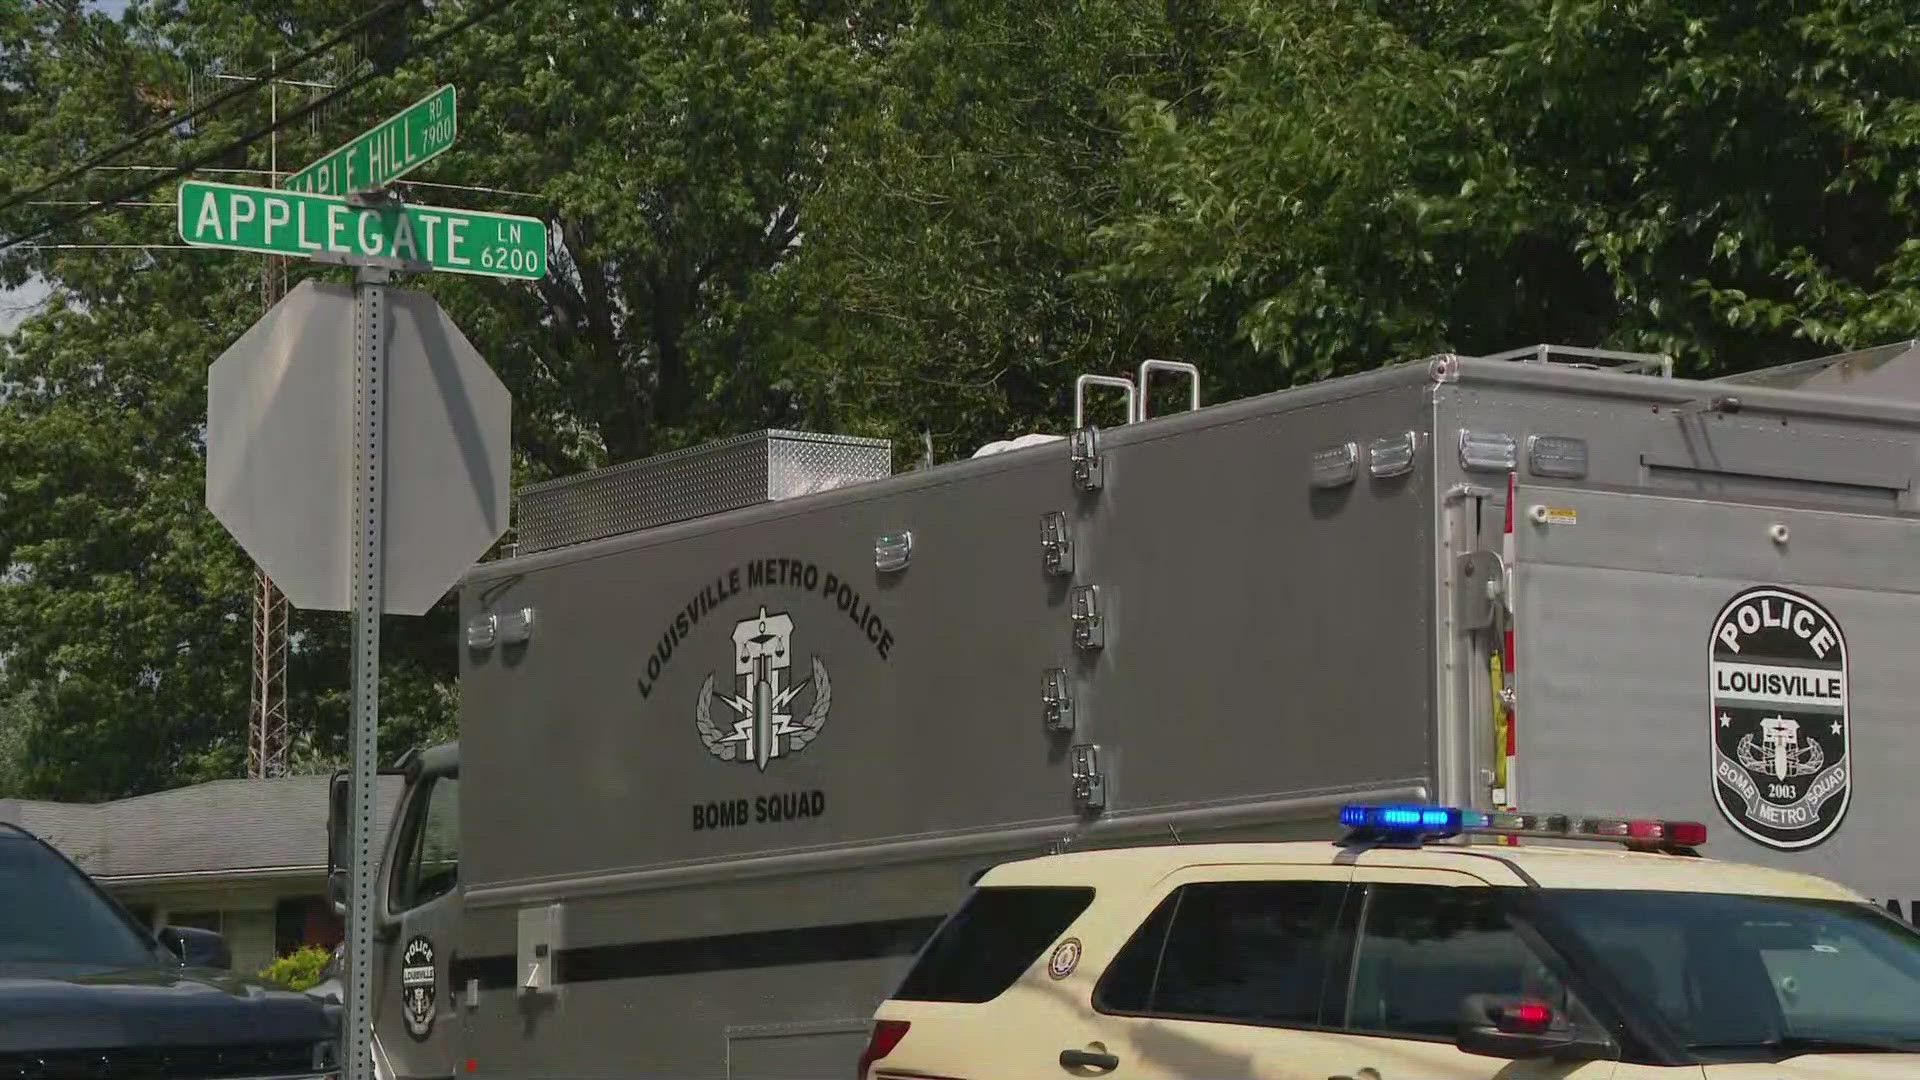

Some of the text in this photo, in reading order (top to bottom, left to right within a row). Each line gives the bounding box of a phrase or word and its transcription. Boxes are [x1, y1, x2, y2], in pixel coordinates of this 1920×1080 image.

[430, 97, 443, 123] RD
[422, 116, 451, 154] 7900
[286, 116, 416, 197] APLE HILL
[195, 190, 471, 266] APPLEGATE
[498, 221, 522, 245] LN
[481, 246, 539, 273] 6200
[637, 557, 895, 700] LOUISVILLE METRO POLICE
[1719, 599, 1837, 660] POLICE
[1717, 670, 1842, 699] LOUISVILLE
[692, 788, 826, 832] BOMB SQUAD
[1719, 761, 1846, 825] BOMB METRO SQUAD
[1768, 783, 1797, 799] 2003
[405, 940, 433, 964] POLICE
